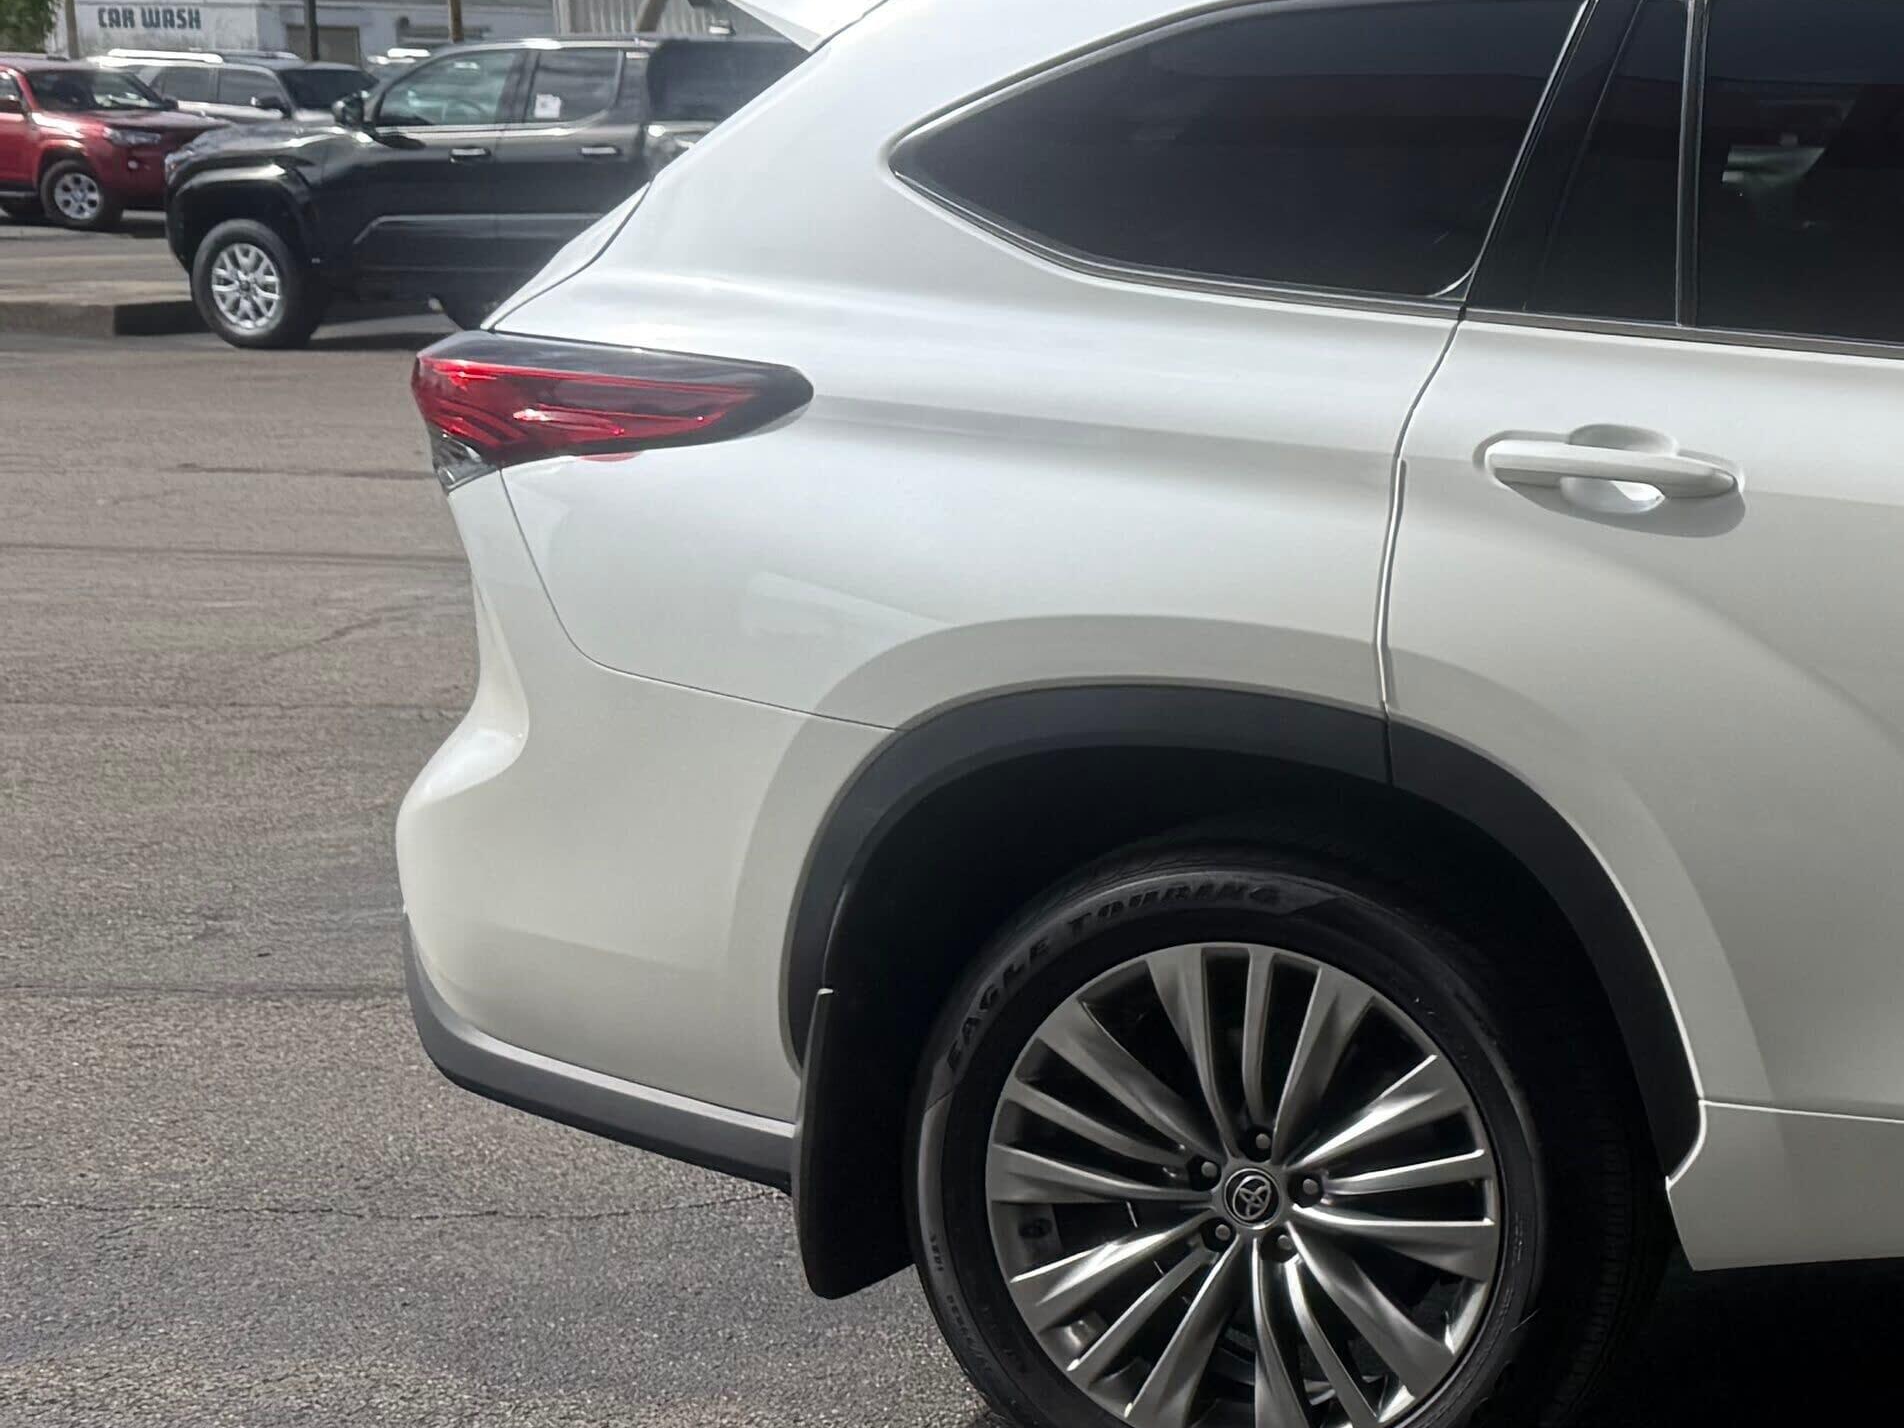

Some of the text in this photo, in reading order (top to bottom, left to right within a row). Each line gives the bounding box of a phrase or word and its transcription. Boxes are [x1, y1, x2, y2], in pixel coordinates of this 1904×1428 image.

[98, 6, 202, 29] CAR WASH
[945, 937, 1050, 1073] EAGLE
